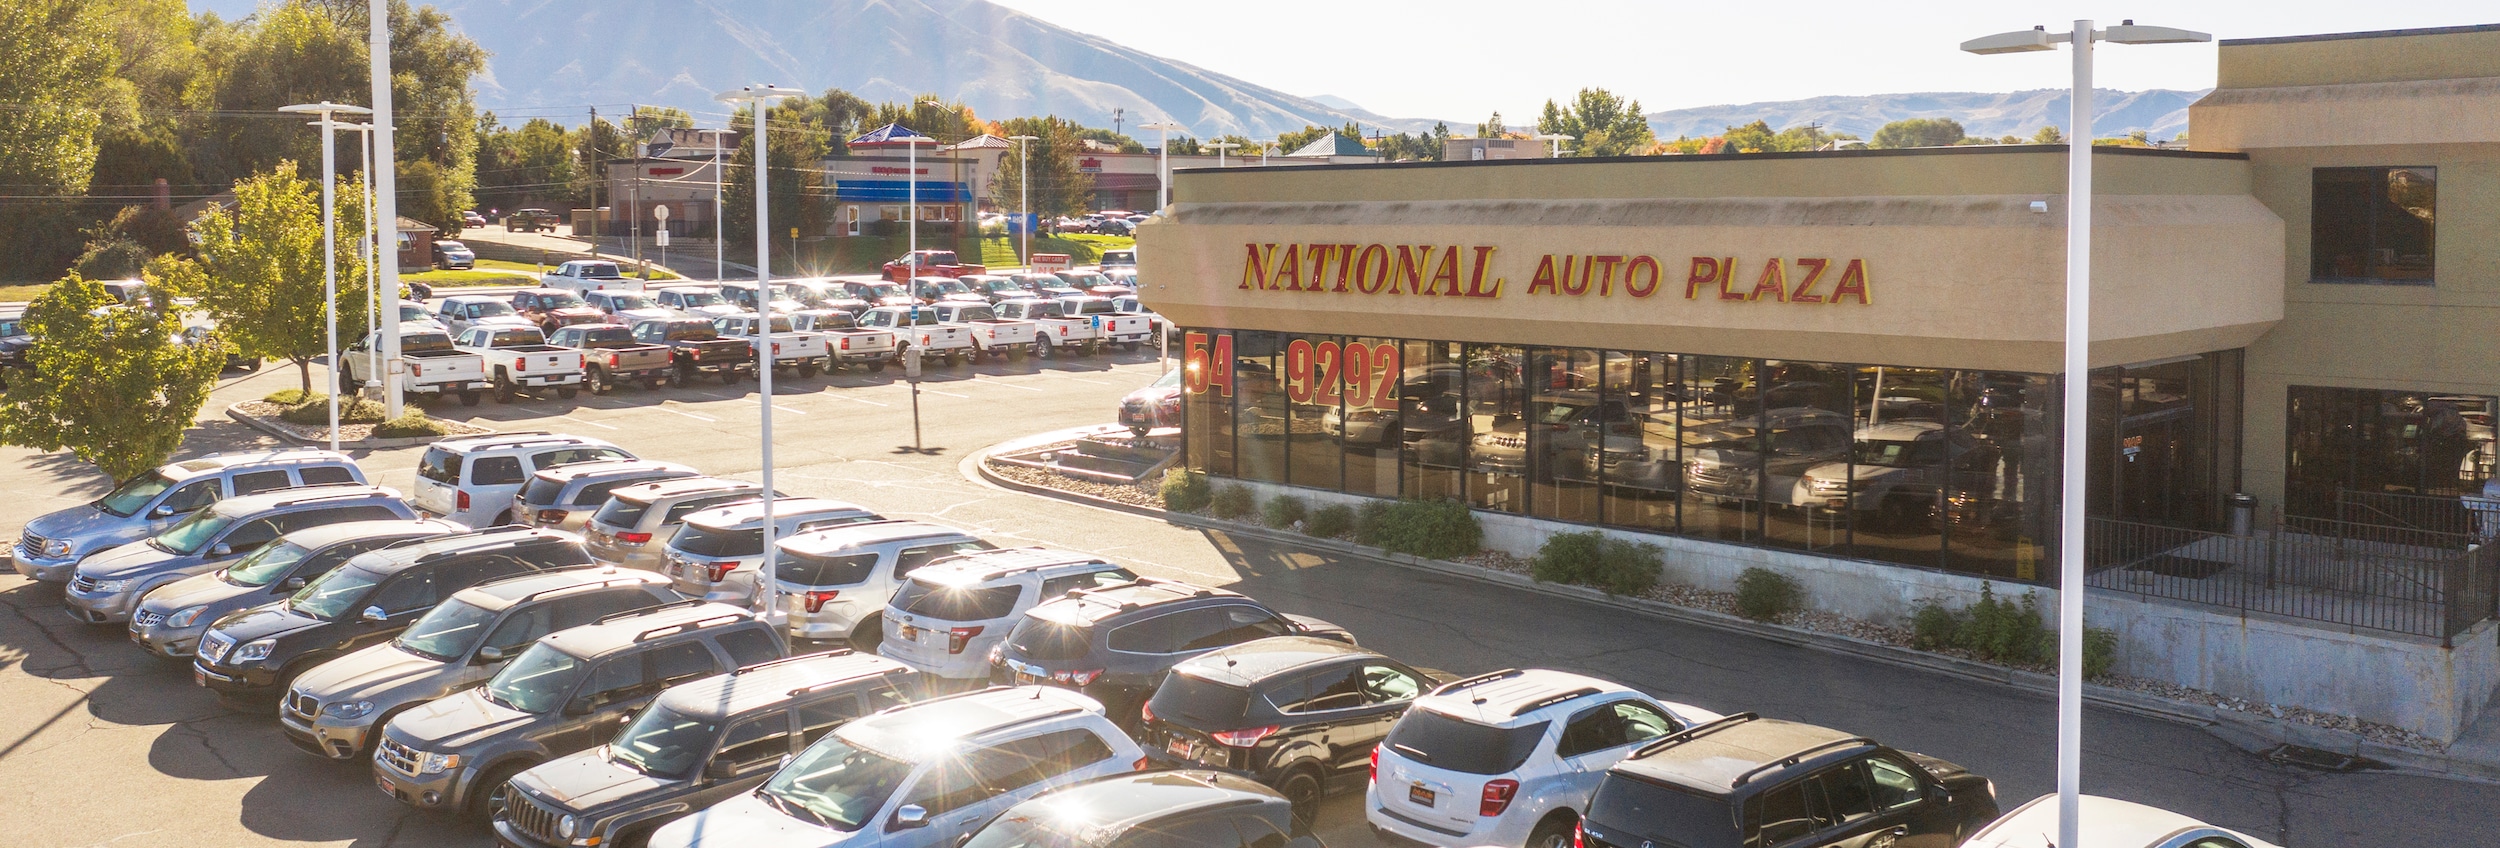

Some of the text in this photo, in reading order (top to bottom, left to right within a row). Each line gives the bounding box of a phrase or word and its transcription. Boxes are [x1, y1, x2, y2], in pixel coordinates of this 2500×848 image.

[1238, 243, 1872, 305] NATIONAL AUTO PLAZA
[1184, 331, 1400, 412] 54 9292
